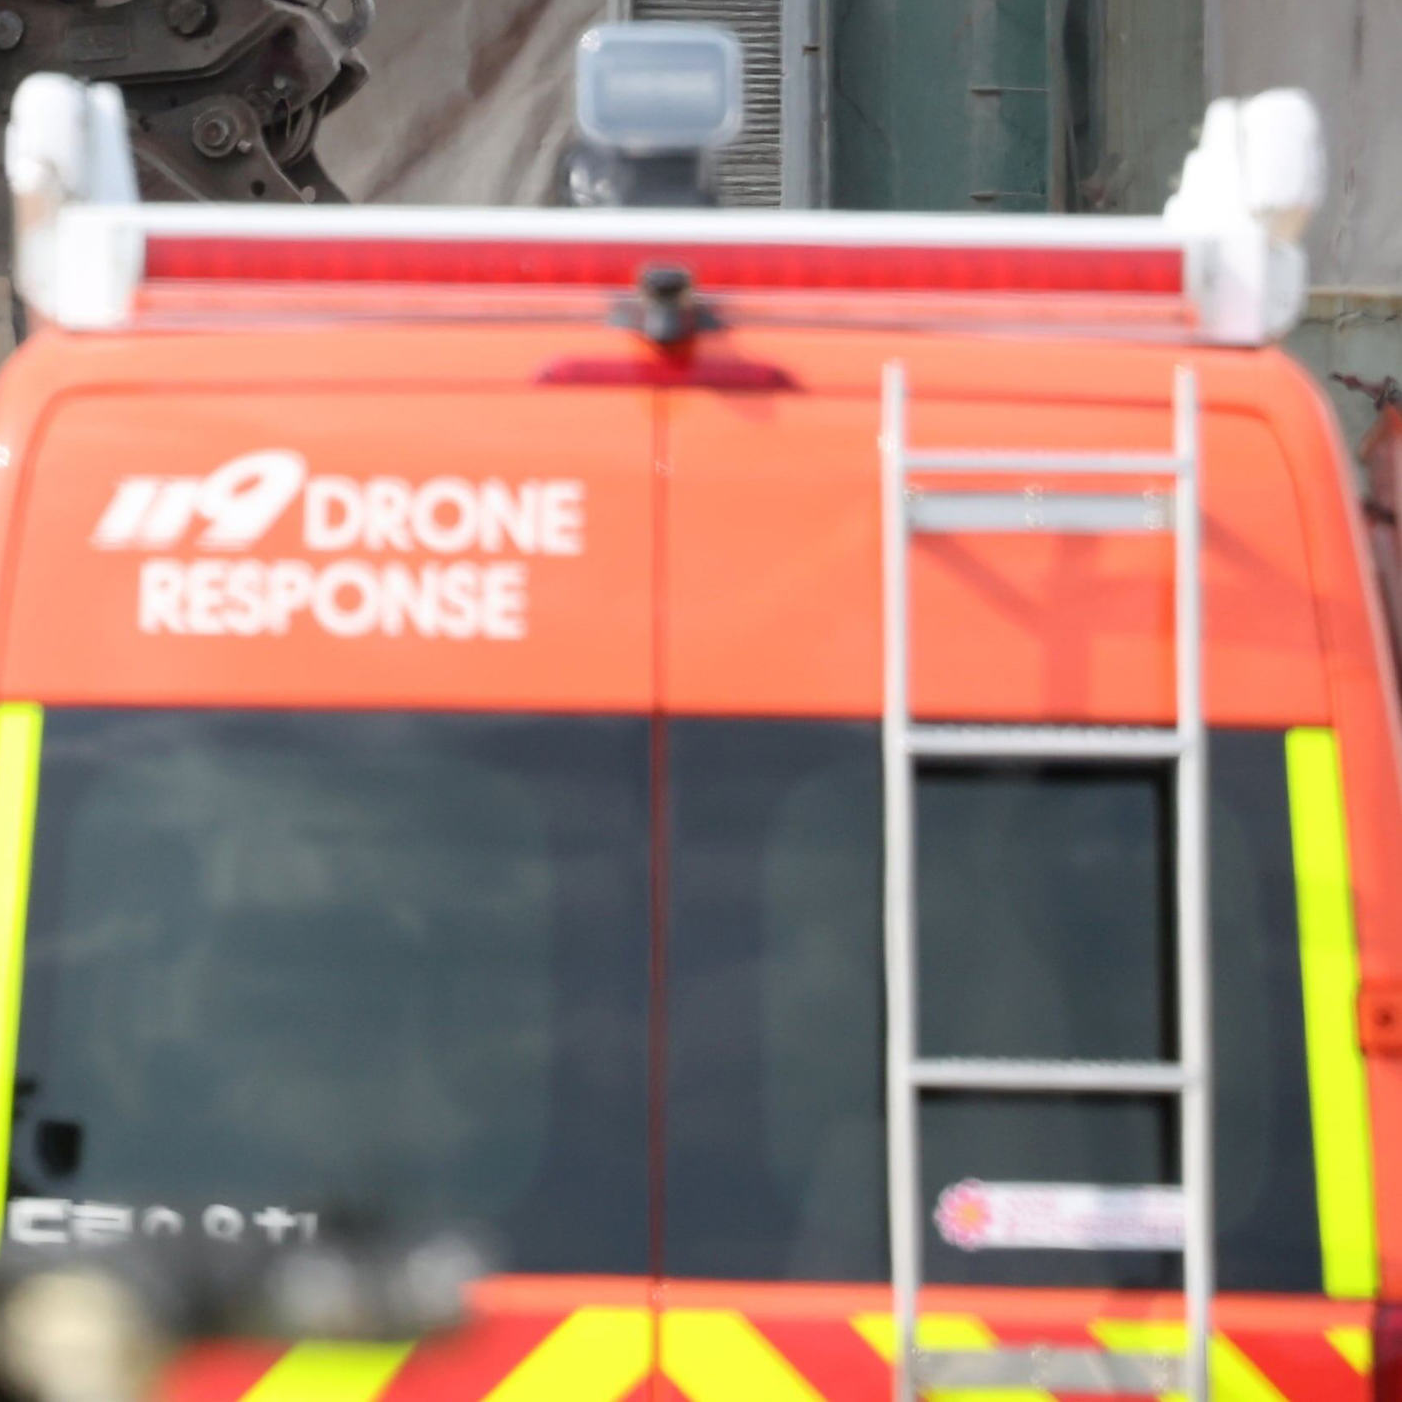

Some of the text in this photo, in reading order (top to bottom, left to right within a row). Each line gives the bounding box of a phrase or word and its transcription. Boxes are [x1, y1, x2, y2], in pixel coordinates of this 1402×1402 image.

[93, 448, 586, 556] 119 DRONE
[138, 558, 529, 639] RESPONSE
